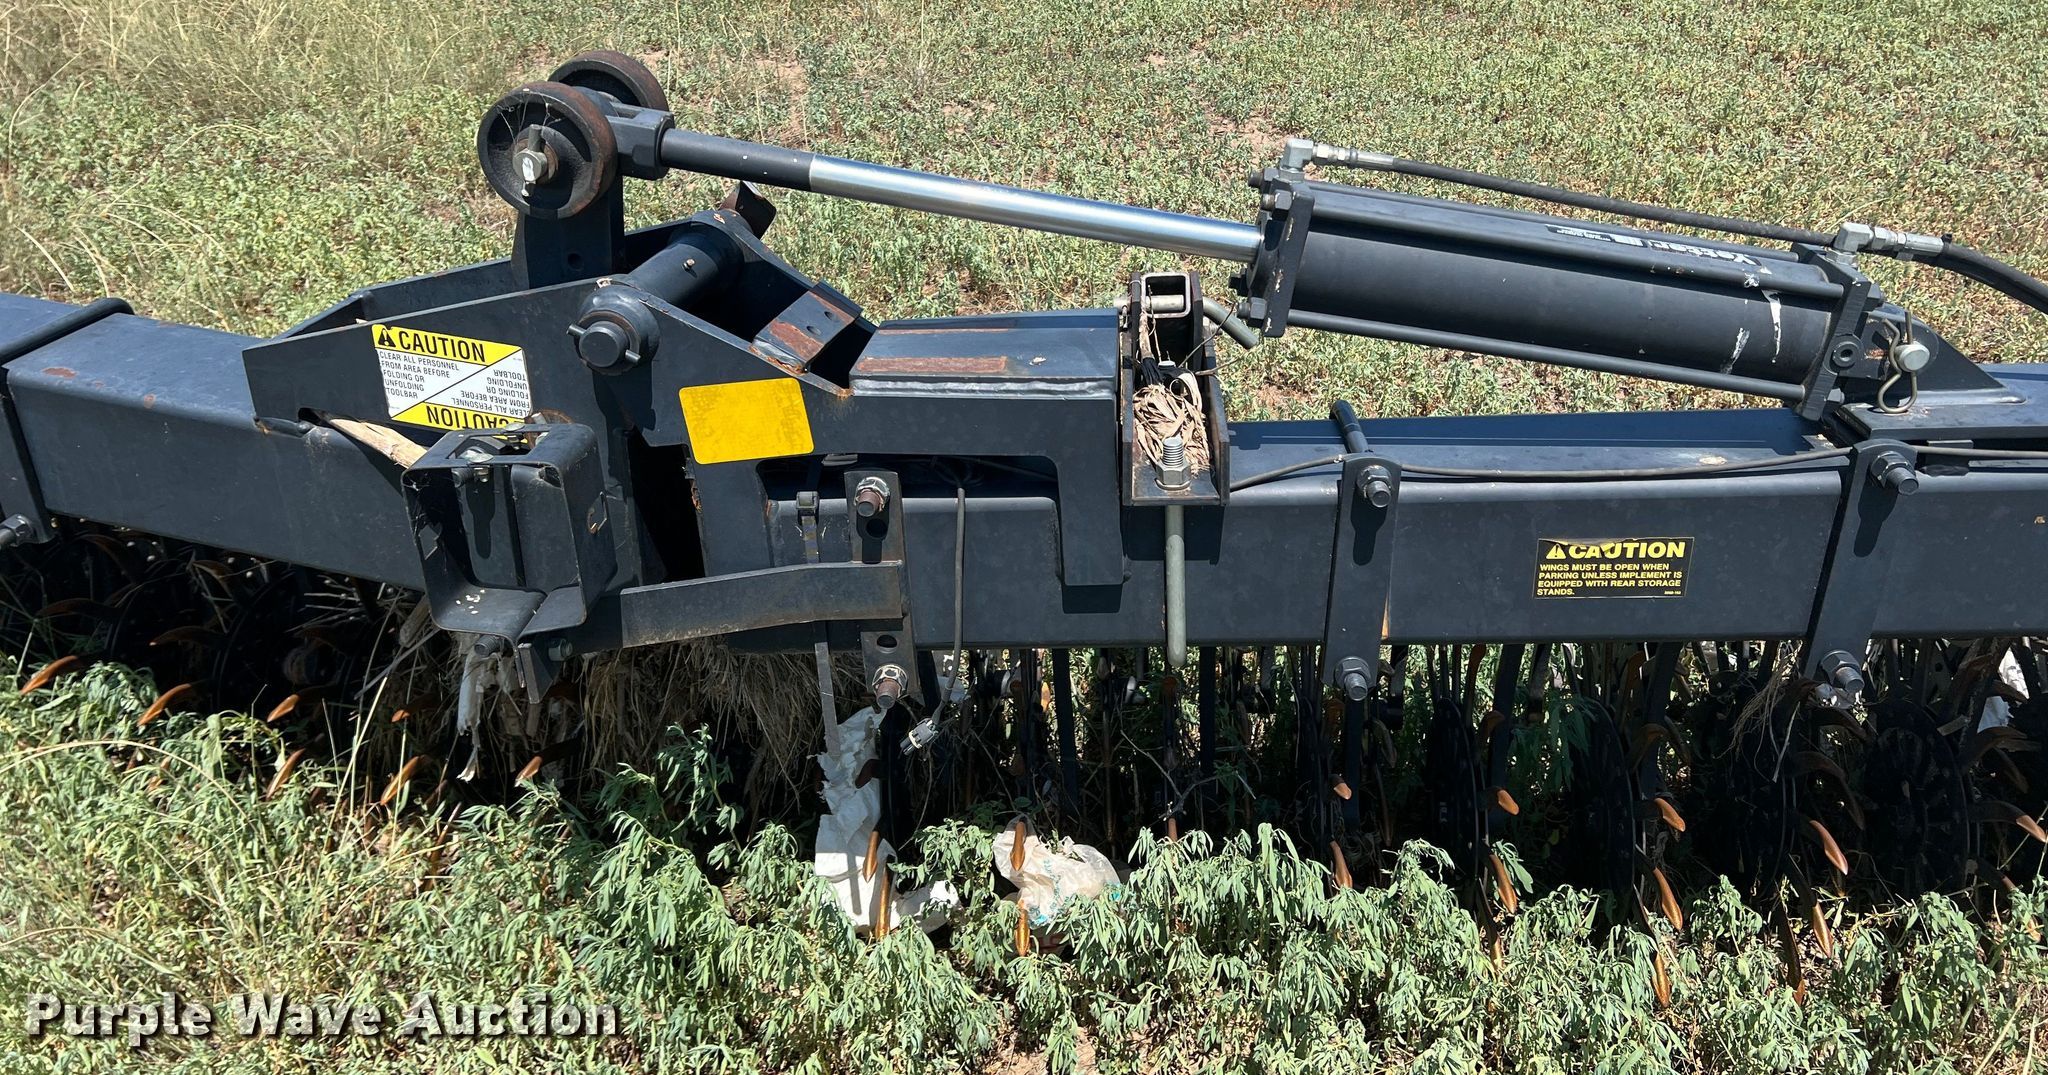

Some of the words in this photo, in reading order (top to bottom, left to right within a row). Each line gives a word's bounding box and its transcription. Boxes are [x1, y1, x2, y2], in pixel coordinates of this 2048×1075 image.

[398, 331, 485, 362] CAUTION
[380, 351, 401, 361] CLEAR
[404, 355, 415, 364] ALL
[418, 357, 459, 371] PERSONNEL
[381, 361, 401, 369] FROM
[403, 364, 421, 373] AREA
[423, 367, 450, 378] BEFORE
[383, 370, 412, 380] FOLDING
[493, 369, 526, 381] TOOLBAR
[384, 379, 424, 391] UNFOLDING
[486, 377, 527, 390] UNFOLDING
[385, 387, 418, 399] TOOLBAR
[460, 390, 488, 401] BEFORE
[486, 386, 496, 394] OR
[499, 388, 529, 399] FOLDING
[451, 397, 493, 411] PERSONNEL
[489, 395, 509, 405] AREA
[509, 399, 530, 409] FROM
[496, 405, 507, 413] ALL
[1568, 542, 1686, 559] CAUTION
